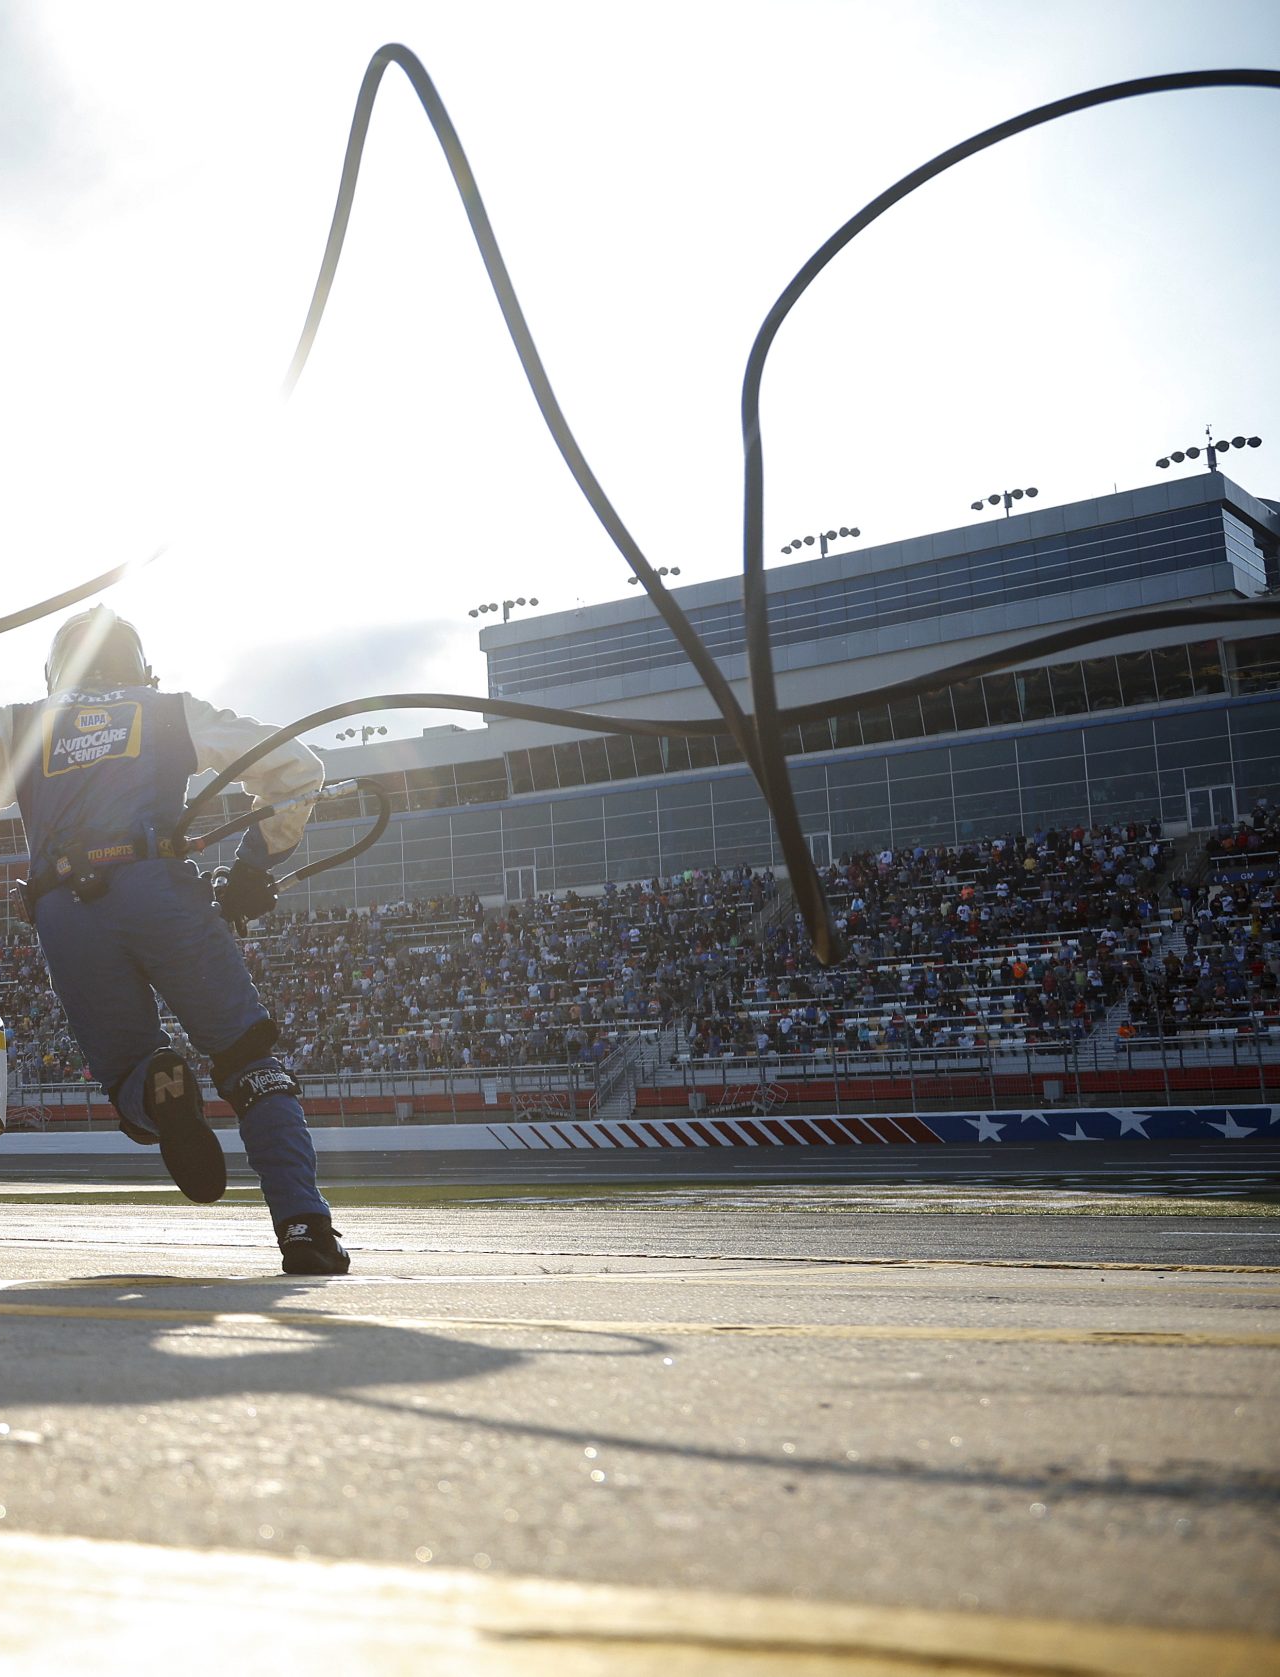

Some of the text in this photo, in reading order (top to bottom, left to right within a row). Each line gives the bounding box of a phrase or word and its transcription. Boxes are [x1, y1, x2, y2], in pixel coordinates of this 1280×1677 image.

[80, 713, 108, 727] NAPA
[67, 743, 112, 764] CENTER
[104, 844, 134, 857] PARTS
